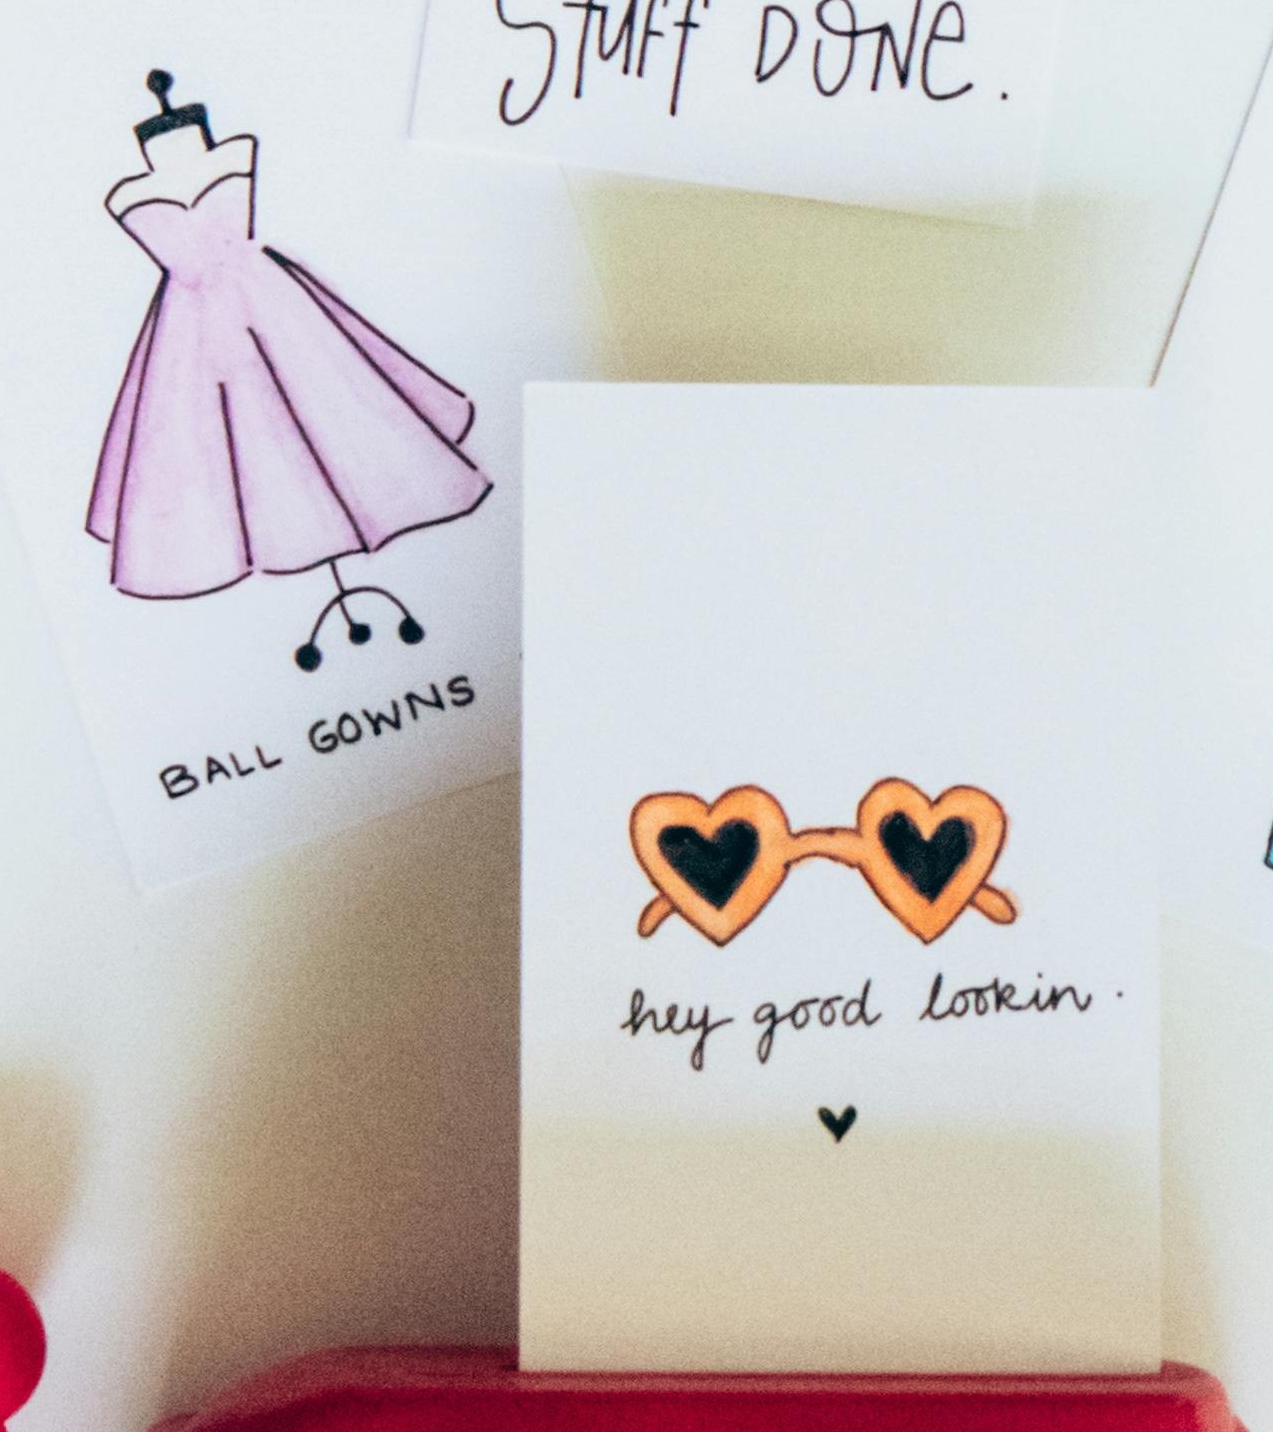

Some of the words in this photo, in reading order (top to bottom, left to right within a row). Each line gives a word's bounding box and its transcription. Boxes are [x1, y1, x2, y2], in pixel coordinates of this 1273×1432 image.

[159, 745, 283, 800] BALL
[307, 674, 477, 754] GOWNS
[621, 988, 733, 1072] hey
[753, 978, 883, 1065] good
